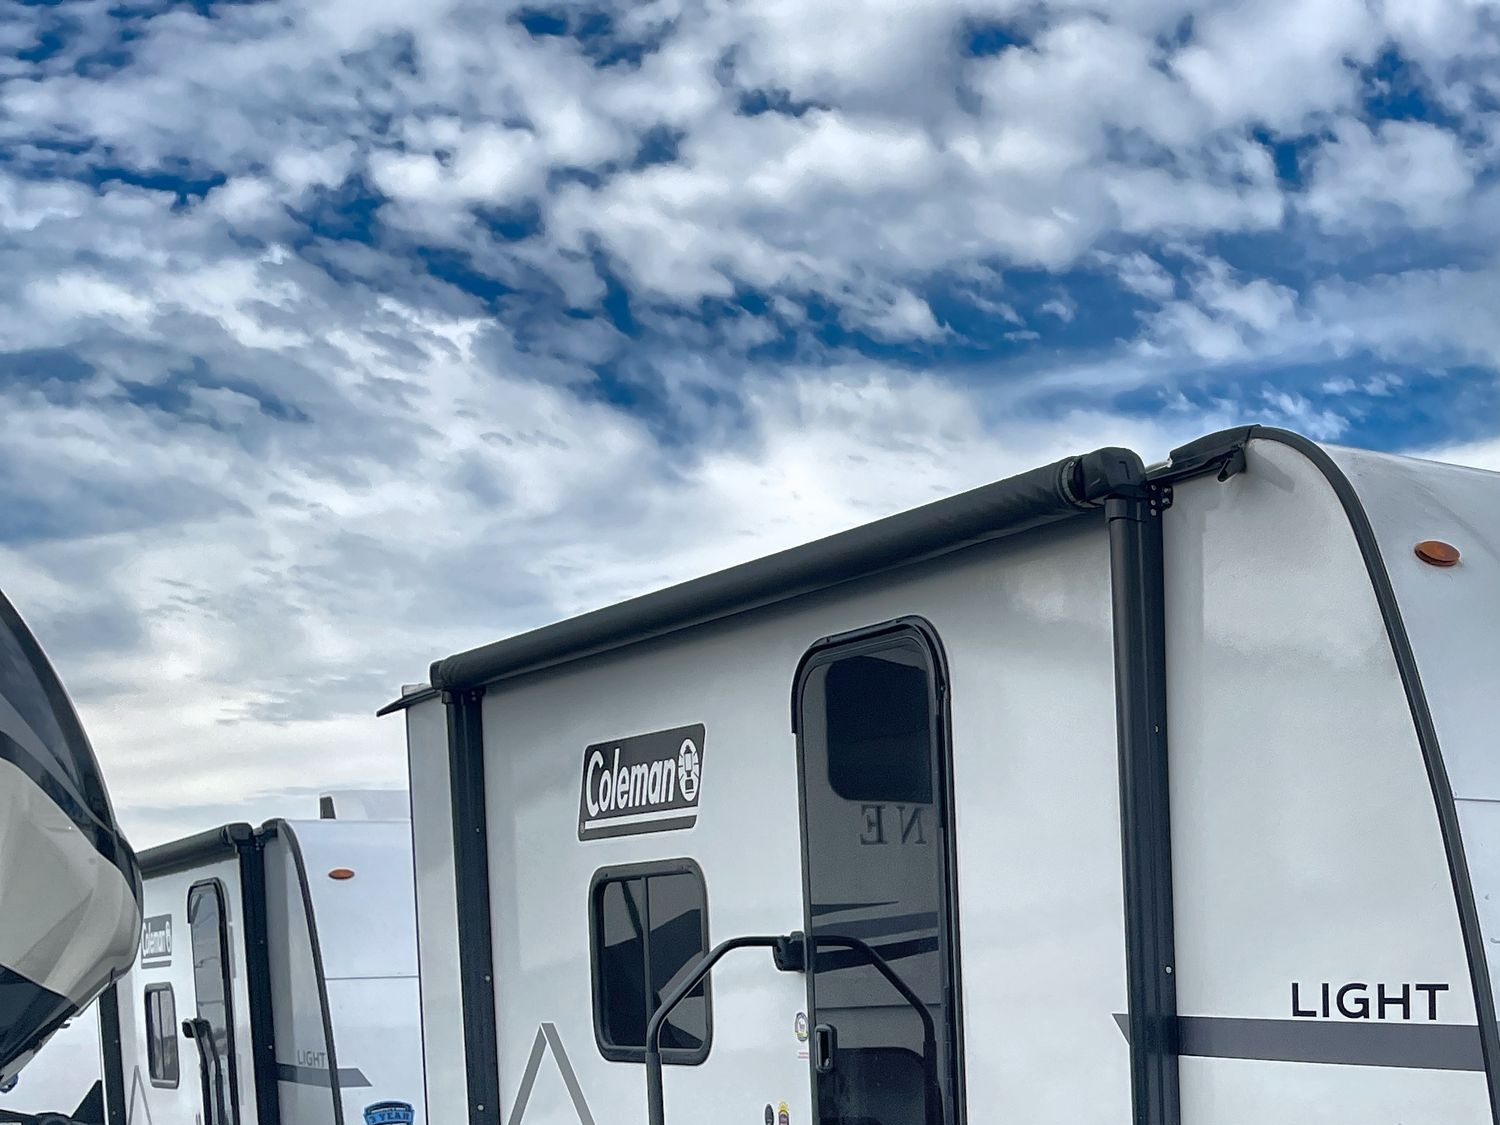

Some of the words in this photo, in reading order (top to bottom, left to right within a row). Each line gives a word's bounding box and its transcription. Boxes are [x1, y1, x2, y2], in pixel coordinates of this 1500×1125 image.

[586, 748, 676, 817] Coleman
[1292, 982, 1449, 1020] LIGHT
[297, 1049, 326, 1068] LIGHT
